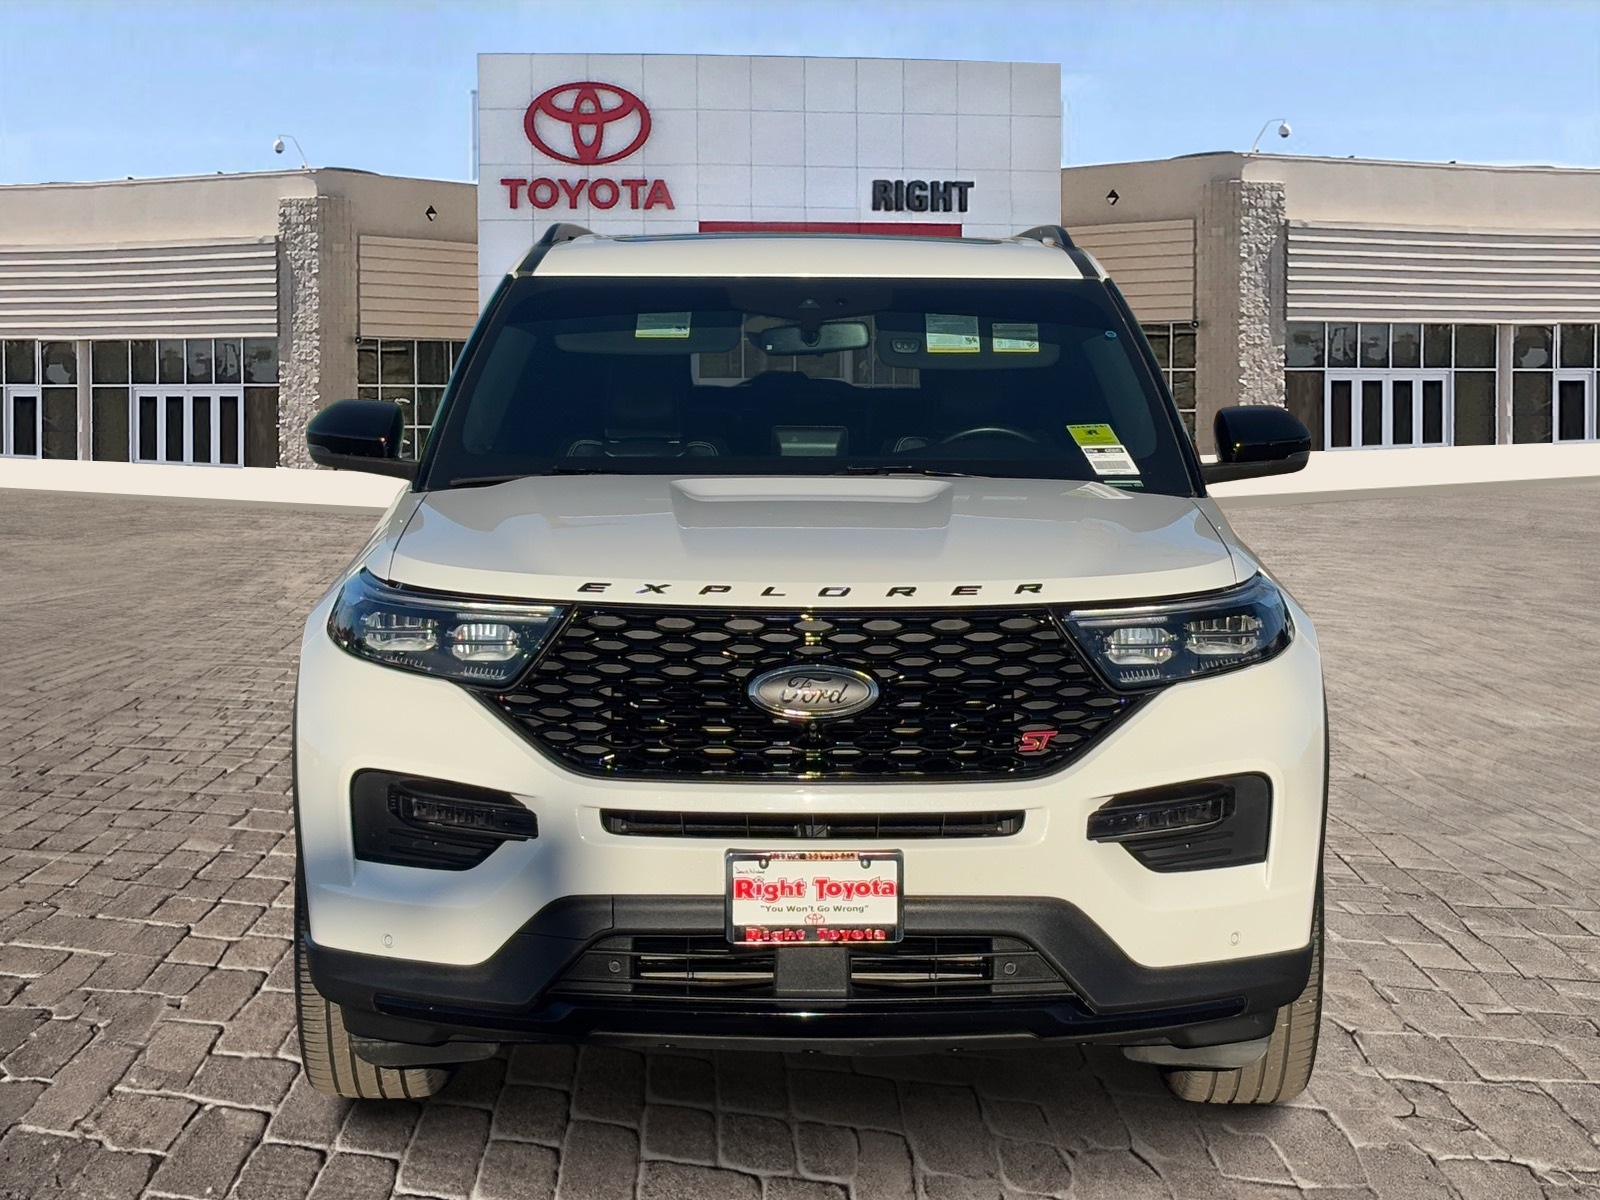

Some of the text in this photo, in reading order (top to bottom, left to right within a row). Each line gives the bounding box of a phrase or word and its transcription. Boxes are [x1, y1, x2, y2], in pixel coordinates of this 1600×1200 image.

[500, 179, 675, 210] TOYOTA
[872, 180, 975, 212] RIGHT
[577, 582, 1043, 597] EXPLORER
[779, 675, 849, 705] Ford
[1019, 729, 1058, 751] ST
[734, 877, 897, 902] Right Toyota
[760, 905, 869, 914] "You Won't Go Wrong"
[745, 928, 886, 942] Right Toyota
